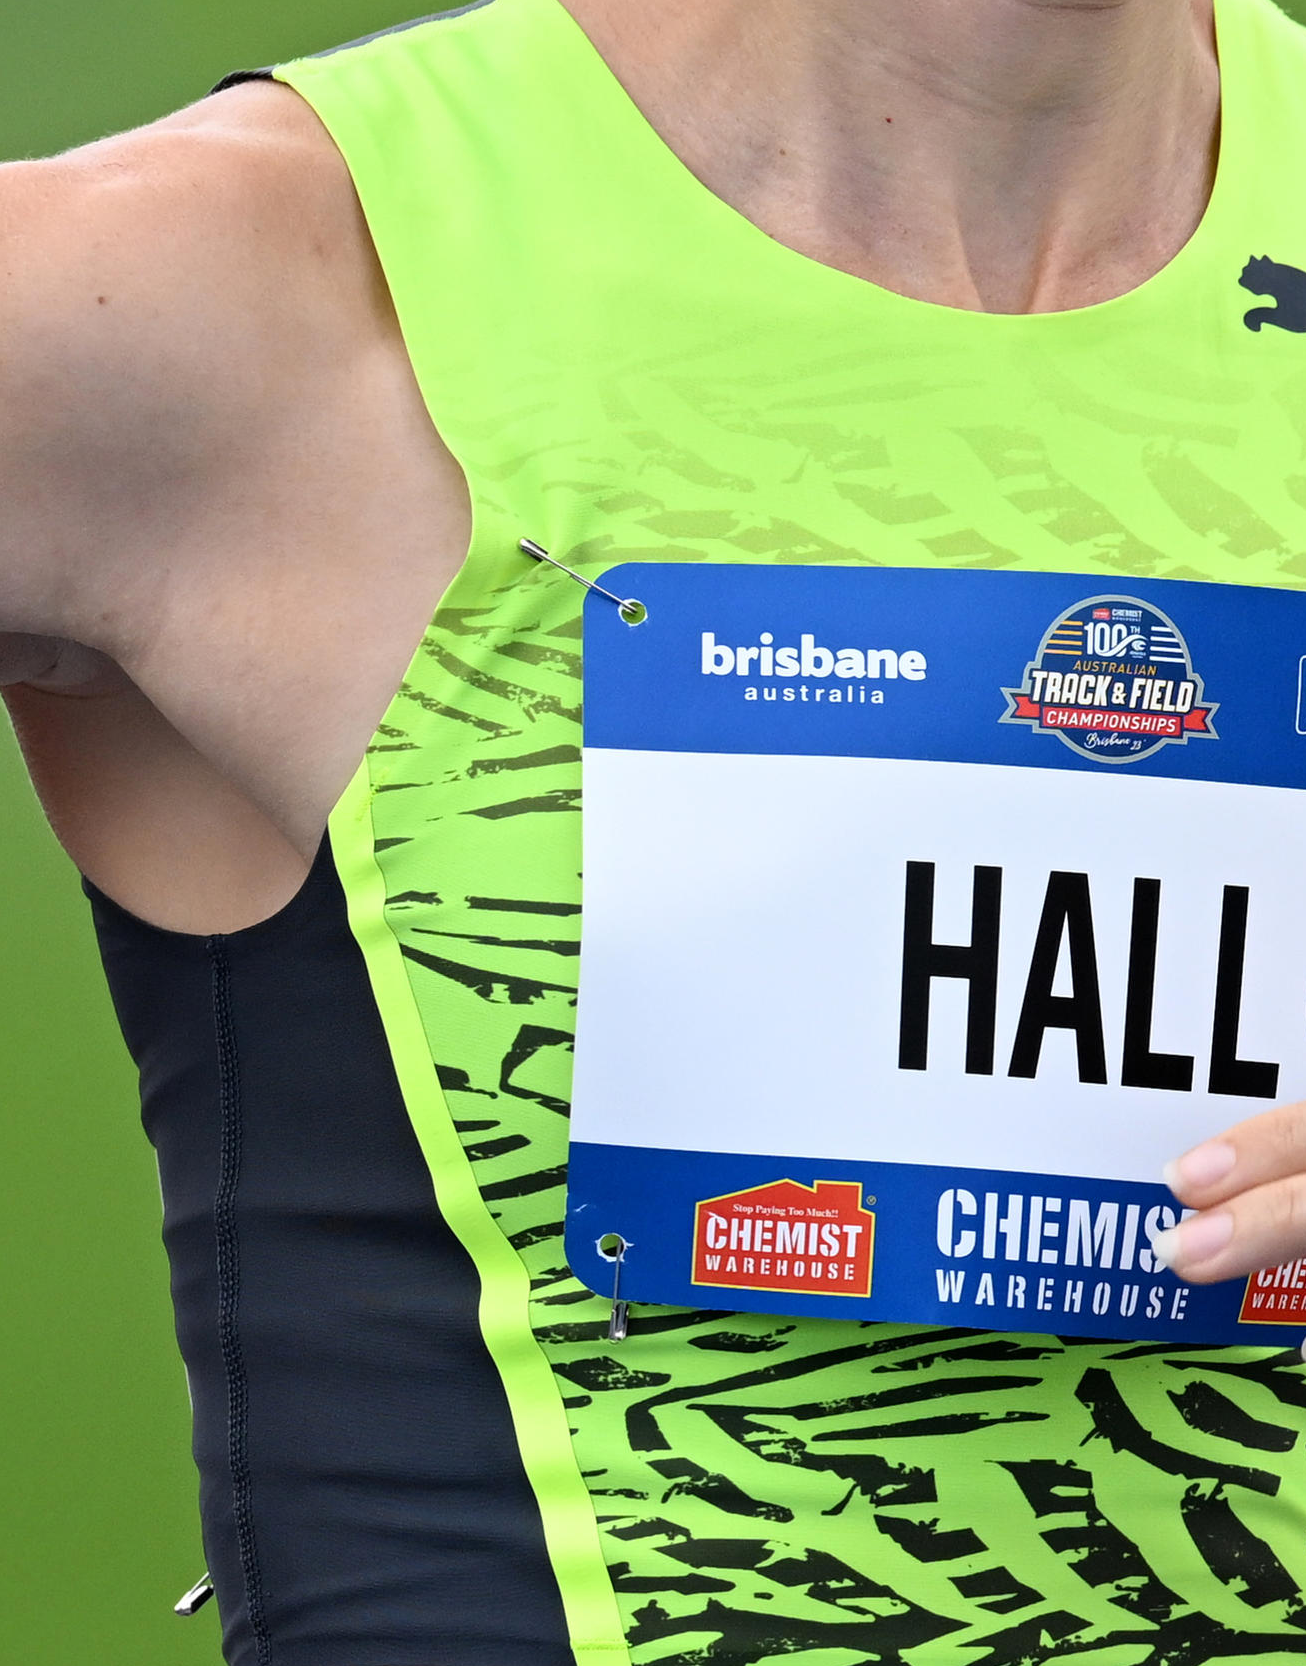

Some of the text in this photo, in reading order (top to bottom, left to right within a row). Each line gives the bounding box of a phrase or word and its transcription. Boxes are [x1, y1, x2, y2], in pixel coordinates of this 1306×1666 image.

[701, 632, 927, 681] brisbane
[1073, 660, 1158, 676] AUSTRALIAN
[744, 684, 884, 704] australia
[1032, 670, 1195, 713] TRACK & FIELD
[1046, 711, 1176, 733] CHAMPIONSHIPS
[1084, 732, 1130, 749] Brisbane
[898, 860, 1280, 1100] HALL
[732, 1203, 839, 1218] Stop Paying Too Much!!
[705, 1216, 863, 1258] CHEMIST
[936, 1188, 1199, 1274] CHEMIS
[705, 1254, 855, 1281] WAREHOUSE
[935, 1269, 1189, 1320] WAREHOUSE
